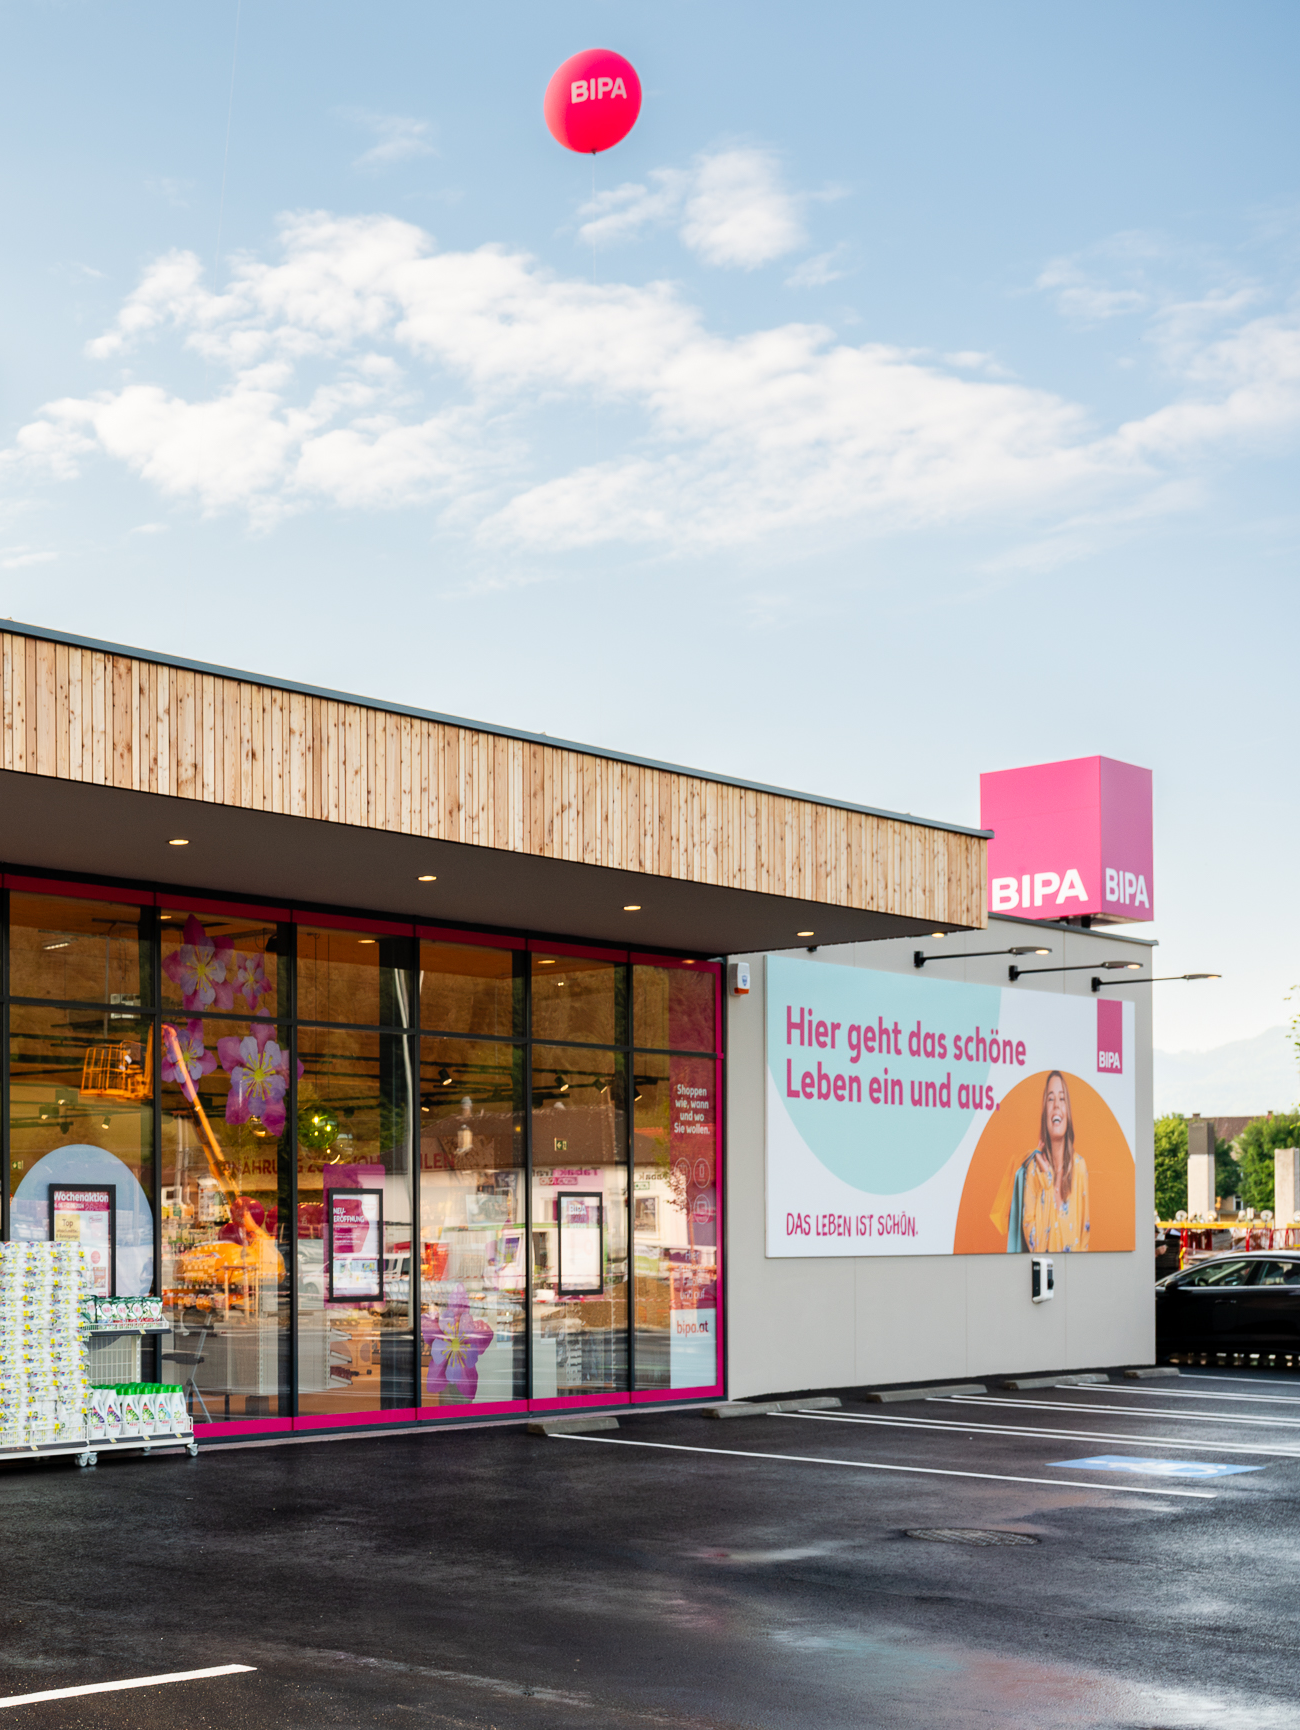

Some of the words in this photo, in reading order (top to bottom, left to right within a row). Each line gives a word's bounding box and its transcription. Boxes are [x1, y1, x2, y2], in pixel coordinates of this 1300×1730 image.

[571, 77, 627, 104] BIPA
[992, 868, 1089, 911] BIPA
[1105, 867, 1149, 908] BIPA
[787, 1005, 841, 1049] Hier
[847, 1016, 902, 1064] geht
[908, 1020, 947, 1059] das
[953, 1026, 1026, 1066] schöne
[1099, 1051, 1121, 1069] BIPA
[677, 1084, 707, 1098] Shoppen
[787, 1058, 861, 1102] Leben
[869, 1067, 903, 1105] ein
[910, 1072, 951, 1108] und
[957, 1083, 1000, 1111] aus.
[675, 1097, 689, 1109] wie,
[691, 1101, 709, 1109] wann
[680, 1111, 693, 1121] und
[694, 1113, 705, 1121] wo
[674, 1122, 685, 1133] Sie
[686, 1123, 710, 1135] wollen.
[54, 1191, 108, 1202] Wochenaktion
[62, 1219, 73, 1228] Top
[787, 1212, 811, 1236] DAS
[816, 1213, 851, 1237] LEBEN
[856, 1214, 874, 1237] IST
[877, 1211, 918, 1237] SCHÖN.
[677, 1320, 709, 1338] bipa.at
